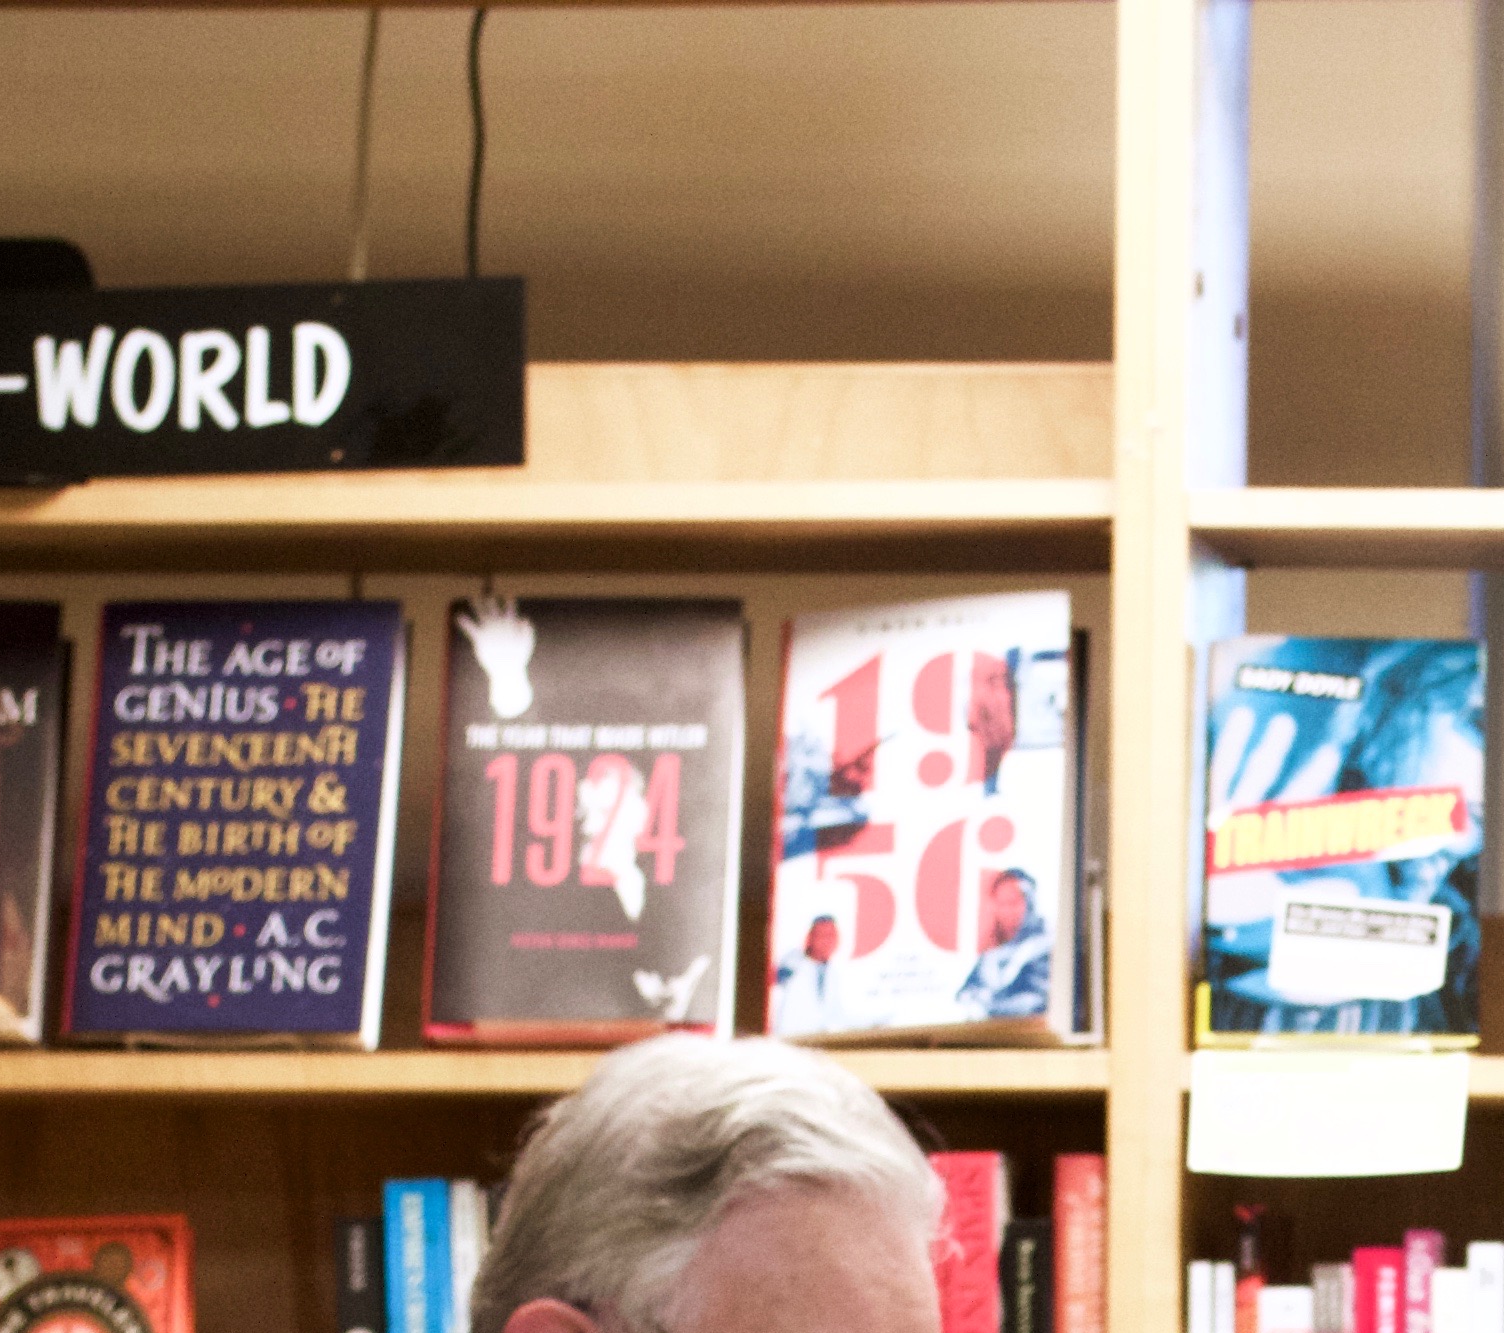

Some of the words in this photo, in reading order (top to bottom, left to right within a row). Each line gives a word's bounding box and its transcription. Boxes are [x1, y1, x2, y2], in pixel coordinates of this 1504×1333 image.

[121, 623, 217, 677] THE
[224, 639, 311, 677] AGE
[112, 683, 281, 722] GENIUS
[816, 650, 1016, 794] 19
[105, 776, 300, 820] CENTURY
[307, 770, 348, 814] &
[176, 818, 300, 858] BIRTH
[484, 752, 688, 888] 1924
[173, 863, 350, 902] MODERN
[95, 912, 227, 948] MIND
[255, 910, 347, 947] A.C.
[90, 954, 343, 1002] GRAYLING
